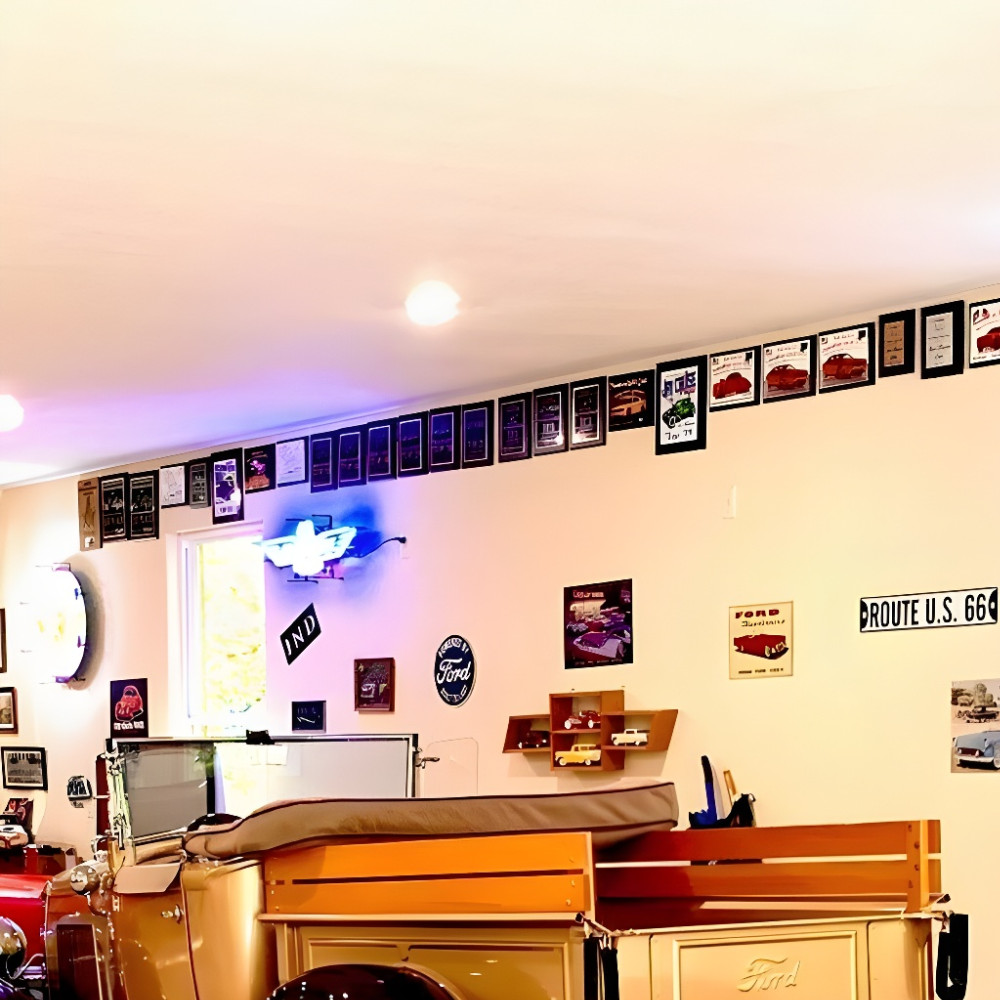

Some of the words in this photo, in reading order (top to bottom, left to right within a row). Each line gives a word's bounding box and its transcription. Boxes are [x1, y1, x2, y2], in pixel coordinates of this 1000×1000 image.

[870, 599, 919, 628] ROUTE
[925, 596, 957, 624] U.S.
[964, 593, 986, 622] 66
[436, 658, 472, 684] Ford
[738, 957, 800, 993] Ford
